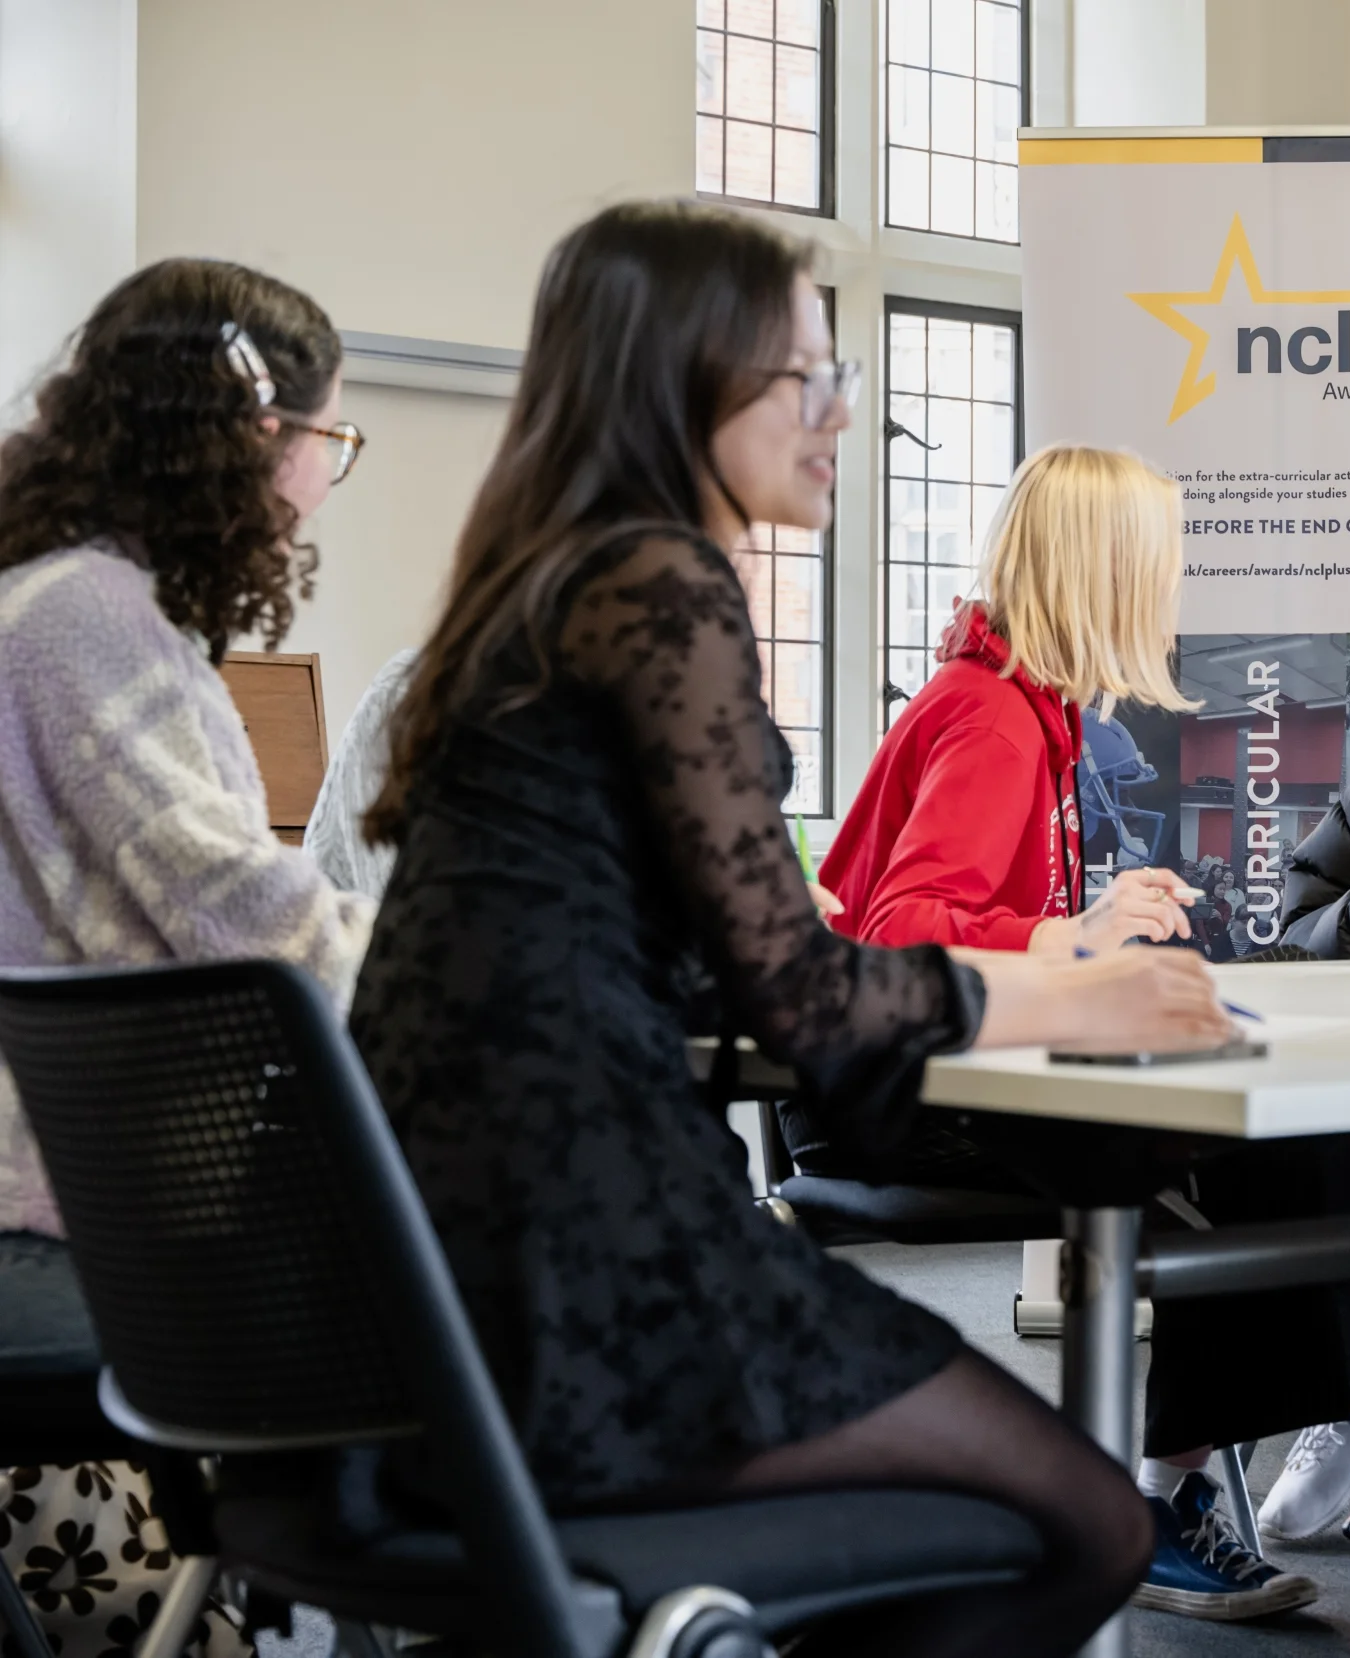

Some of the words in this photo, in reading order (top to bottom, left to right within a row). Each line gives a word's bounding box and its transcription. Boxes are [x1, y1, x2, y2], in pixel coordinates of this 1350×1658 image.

[1195, 469, 1213, 482] for
[1216, 470, 1236, 481] the
[1238, 469, 1332, 482] extra-curricular
[1182, 488, 1216, 504] doing
[1218, 487, 1274, 504] alongside
[1276, 489, 1304, 503] your
[1306, 486, 1348, 499] studies
[1183, 519, 1255, 535] BEFORE
[1258, 519, 1296, 534] THE
[1301, 519, 1341, 534] END
[1246, 660, 1281, 946] CURRICULAR
